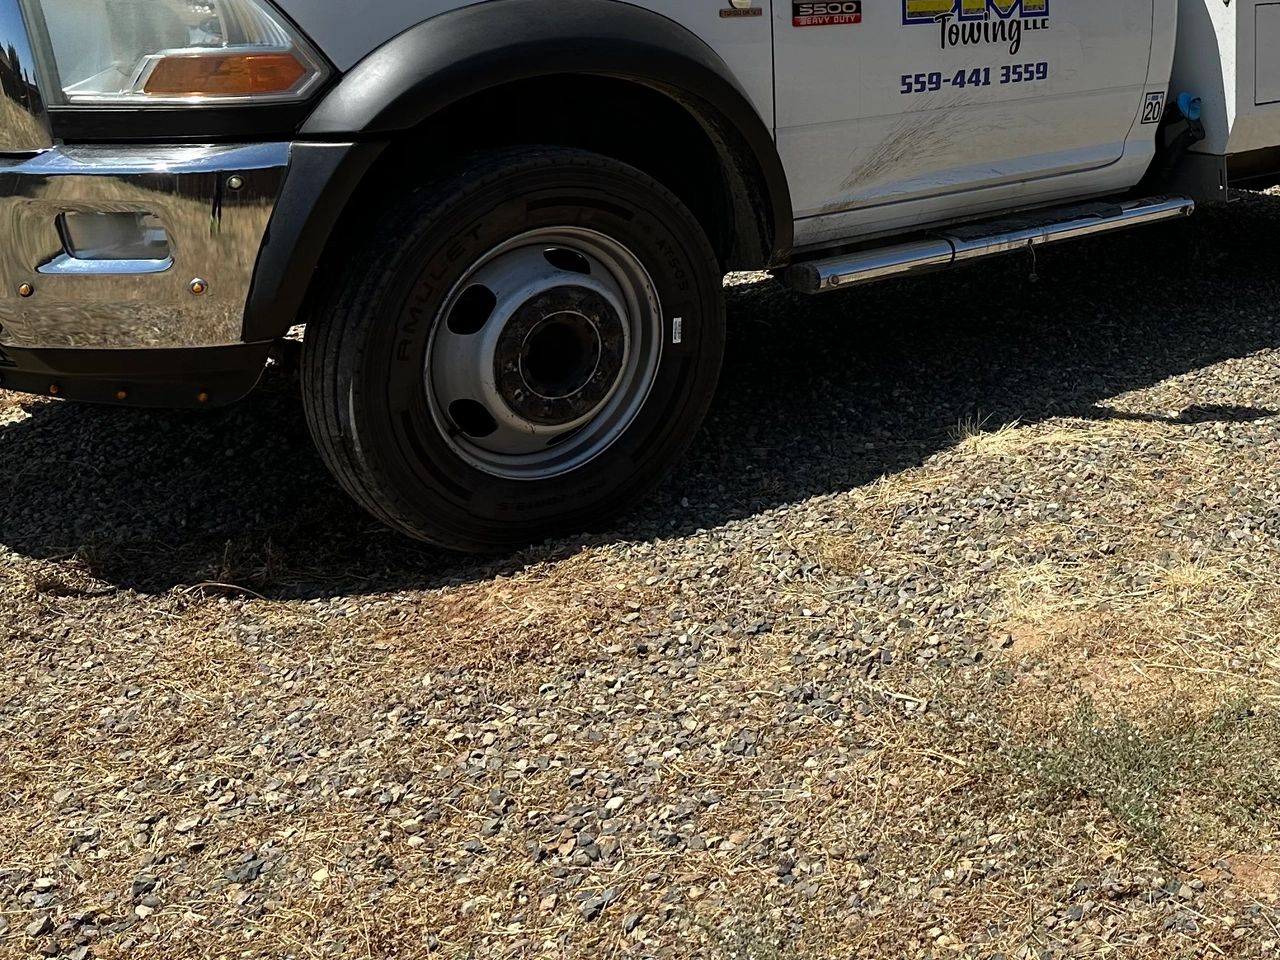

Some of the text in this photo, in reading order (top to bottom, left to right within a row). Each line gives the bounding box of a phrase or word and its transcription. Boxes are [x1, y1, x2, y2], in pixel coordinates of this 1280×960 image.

[799, 2, 857, 16] 5500
[799, 15, 856, 25] HEAVY DUTY
[934, 12, 1049, 56] Towing LLC
[900, 62, 1048, 94] 559-441 3559
[1143, 101, 1161, 121] 20
[397, 223, 483, 361] AMULET
